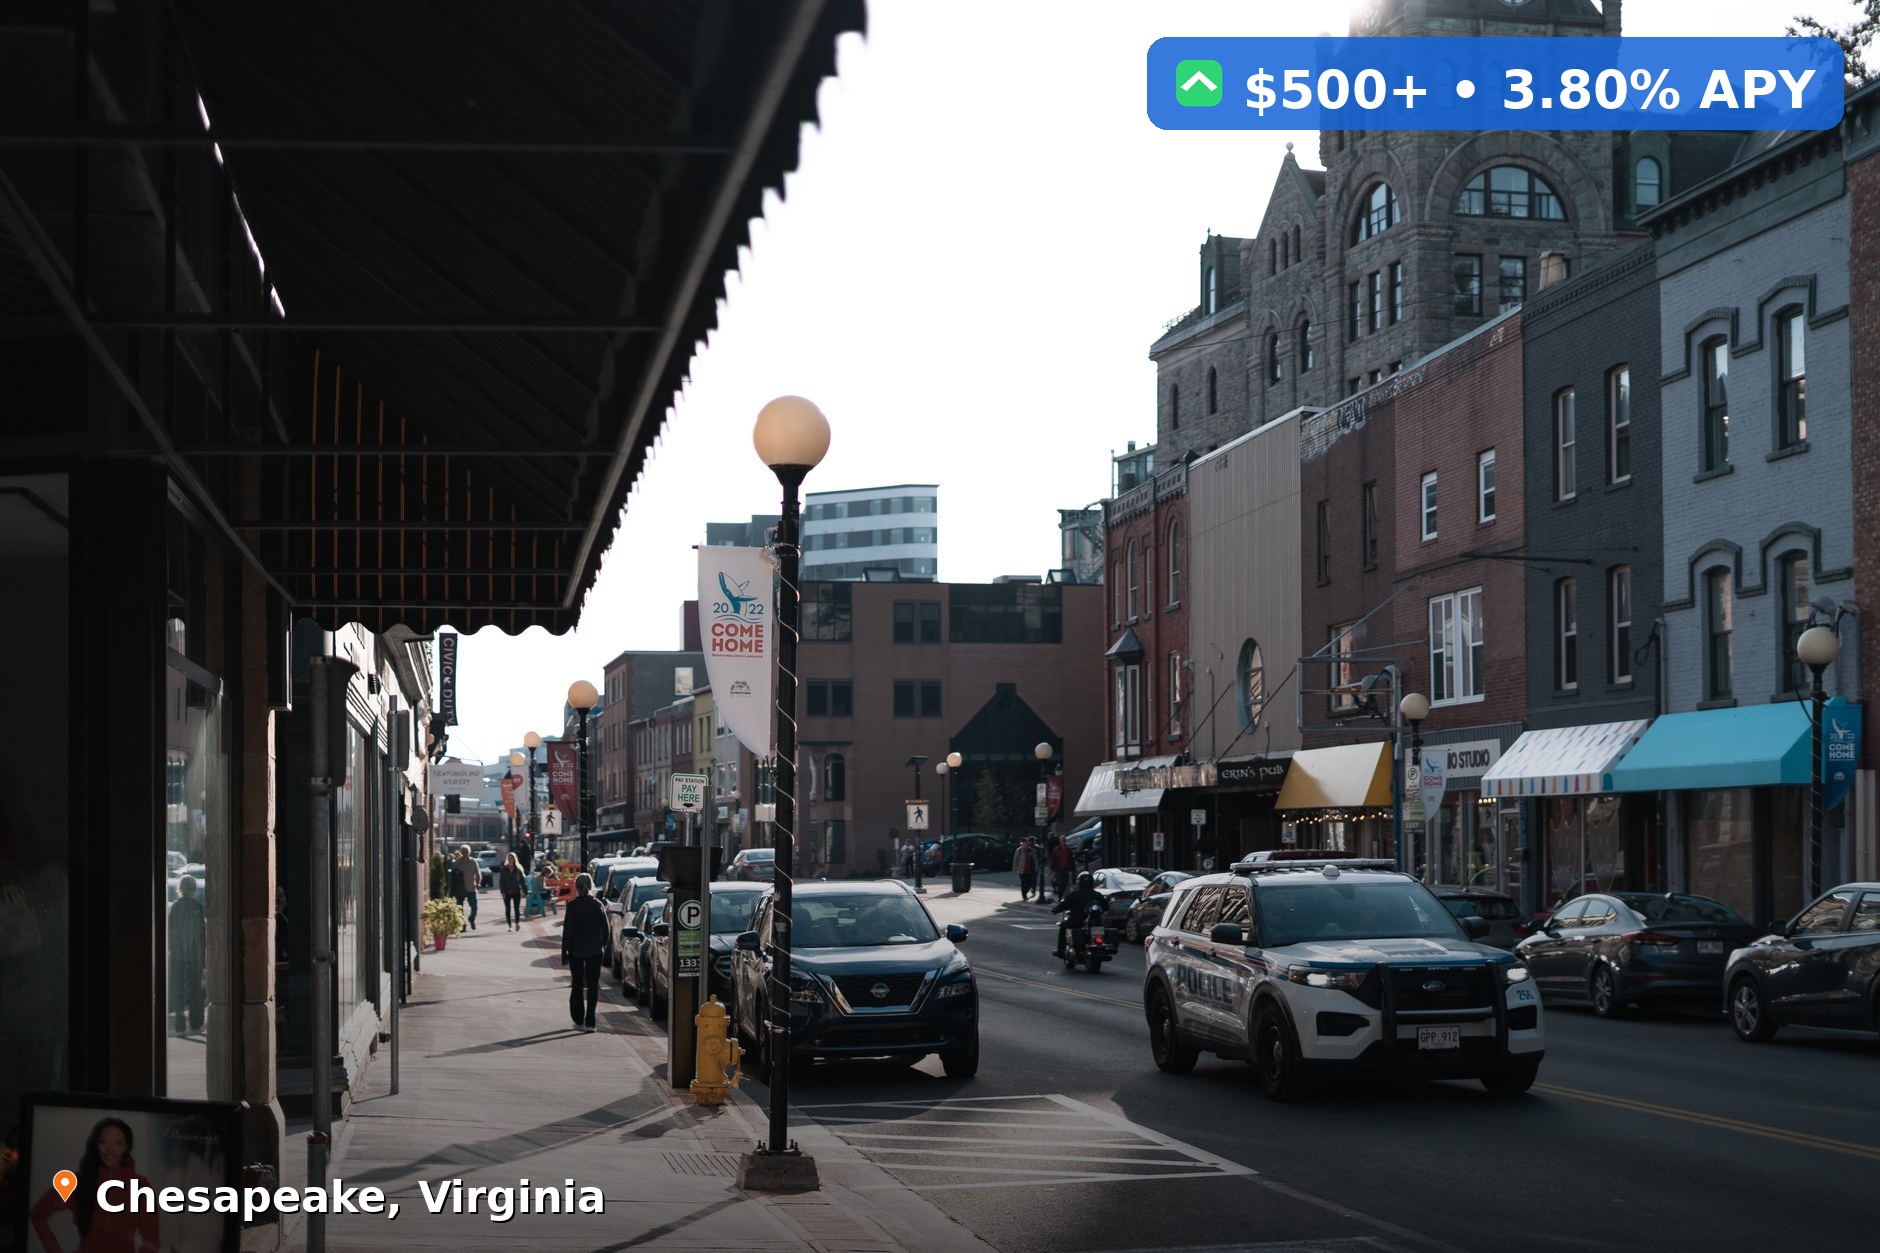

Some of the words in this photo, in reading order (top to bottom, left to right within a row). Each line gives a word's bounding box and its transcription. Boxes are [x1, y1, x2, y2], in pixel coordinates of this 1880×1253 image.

[712, 602, 729, 613] 20
[748, 604, 764, 615] 22
[711, 623, 764, 638] COME
[712, 638, 764, 653] HOME
[442, 637, 455, 676] CIVIC
[443, 689, 456, 725] DUTY
[1828, 743, 1855, 751] COME
[1459, 748, 1490, 769] STUDIO
[1828, 751, 1855, 759] HOME
[681, 784, 698, 793] PAY
[677, 793, 700, 802] HERE
[687, 906, 700, 924] P
[1176, 963, 1234, 1005] POLICE
[1420, 1031, 1437, 1043] GPP
[1442, 1031, 1458, 1042] 912
